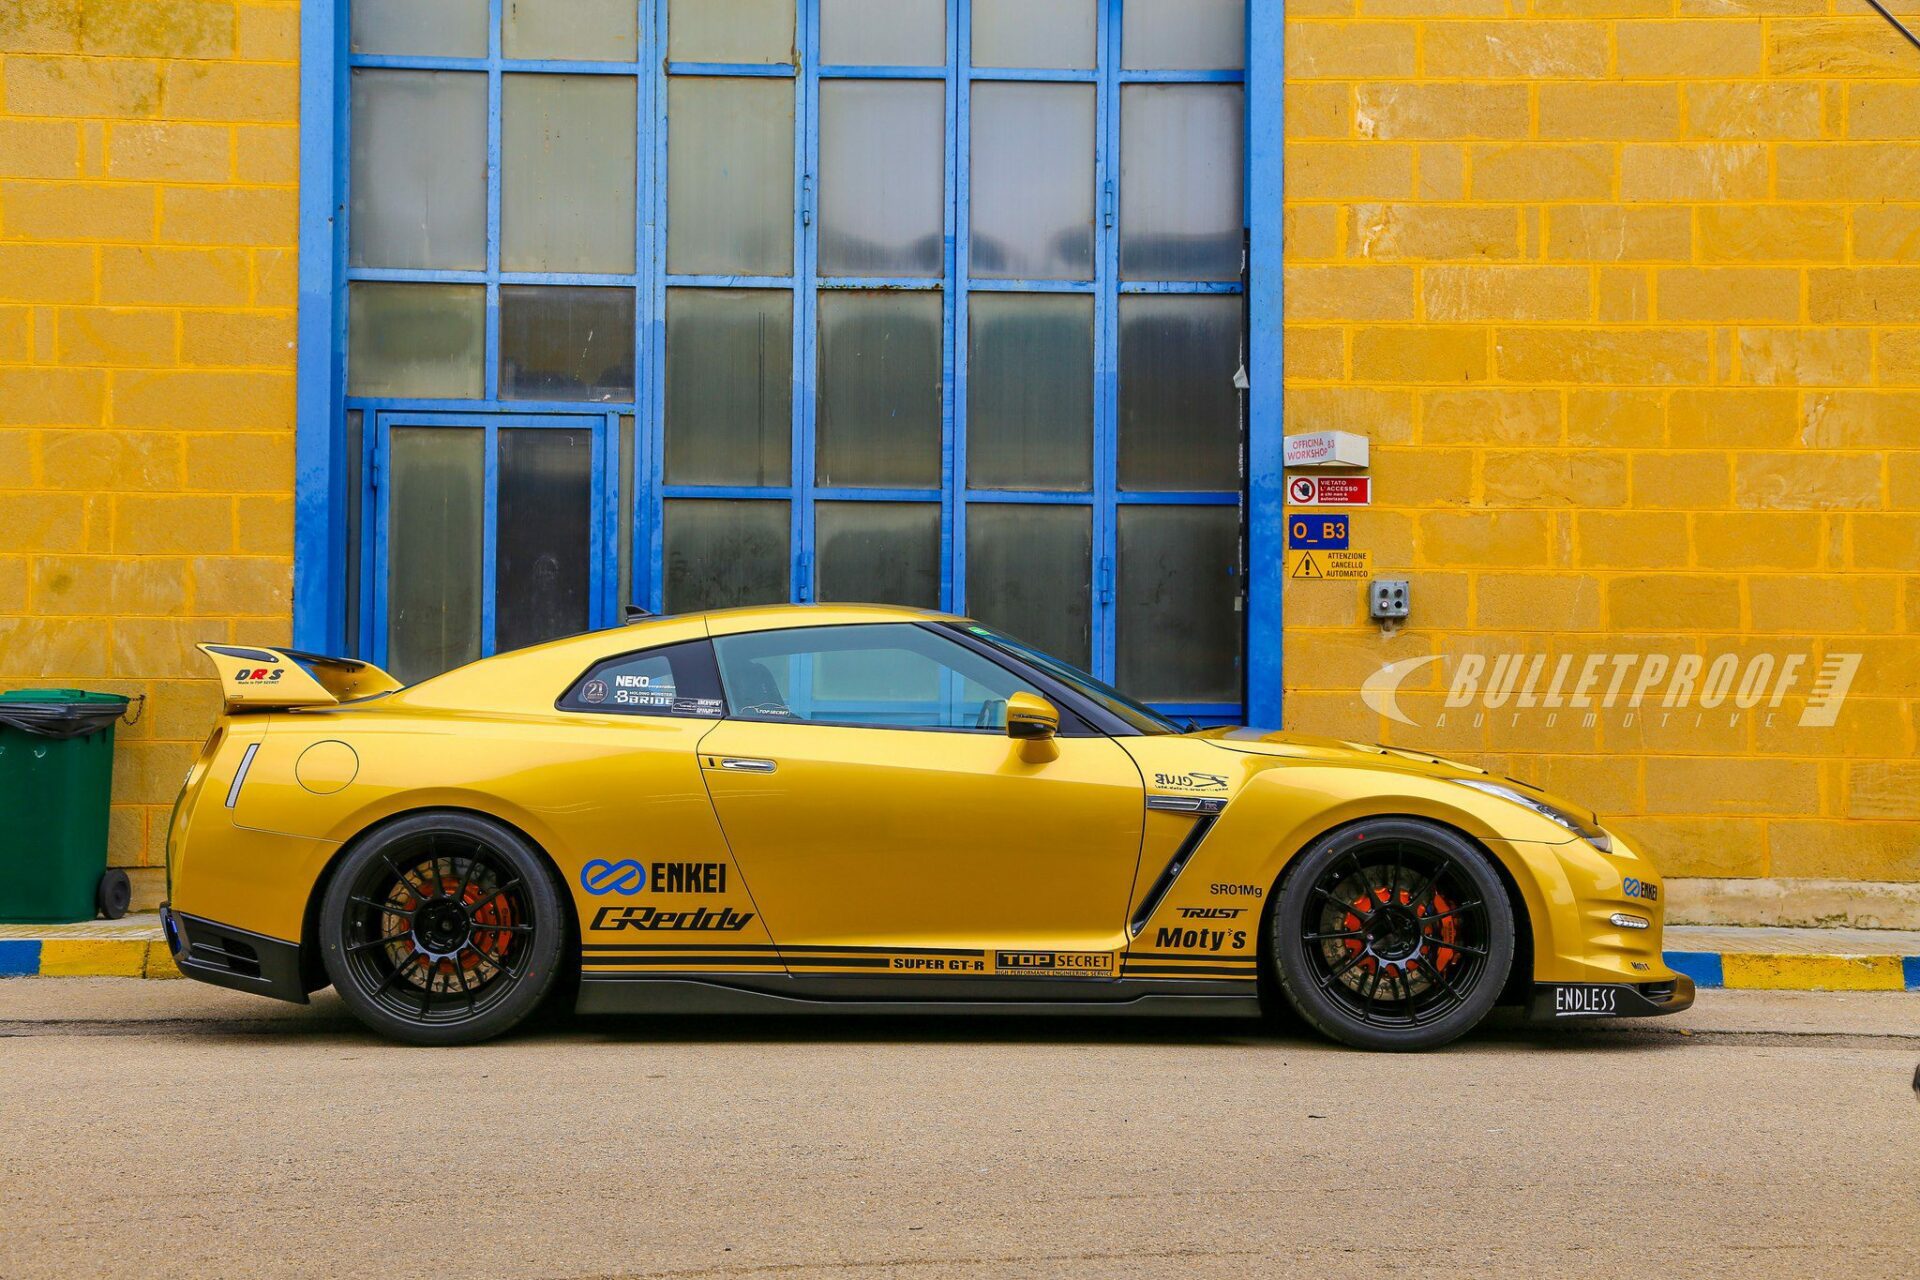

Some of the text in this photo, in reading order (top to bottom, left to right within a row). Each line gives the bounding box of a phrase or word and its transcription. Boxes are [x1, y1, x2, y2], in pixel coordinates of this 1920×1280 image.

[1292, 438, 1324, 450] OFFICINA
[1287, 447, 1328, 461] WORKSHOP
[1323, 522, 1346, 539] B3
[1327, 552, 1367, 560] ATTENZIONE
[1331, 561, 1363, 569] CANCELLO
[1326, 570, 1368, 578] AUTOMATICO
[234, 668, 285, 681] DRS
[615, 675, 650, 688] NEKO
[629, 696, 673, 705] BRIDE
[651, 862, 726, 893] ENKEI
[1640, 881, 1658, 901] ENKEI
[589, 906, 756, 931] GReddy
[1176, 907, 1248, 919] TRUST
[1155, 927, 1247, 951] Moty's
[893, 958, 985, 971] SUPER GT-R
[1003, 954, 1109, 967] TOP SECRET
[1556, 987, 1616, 1011] ENDLESS
